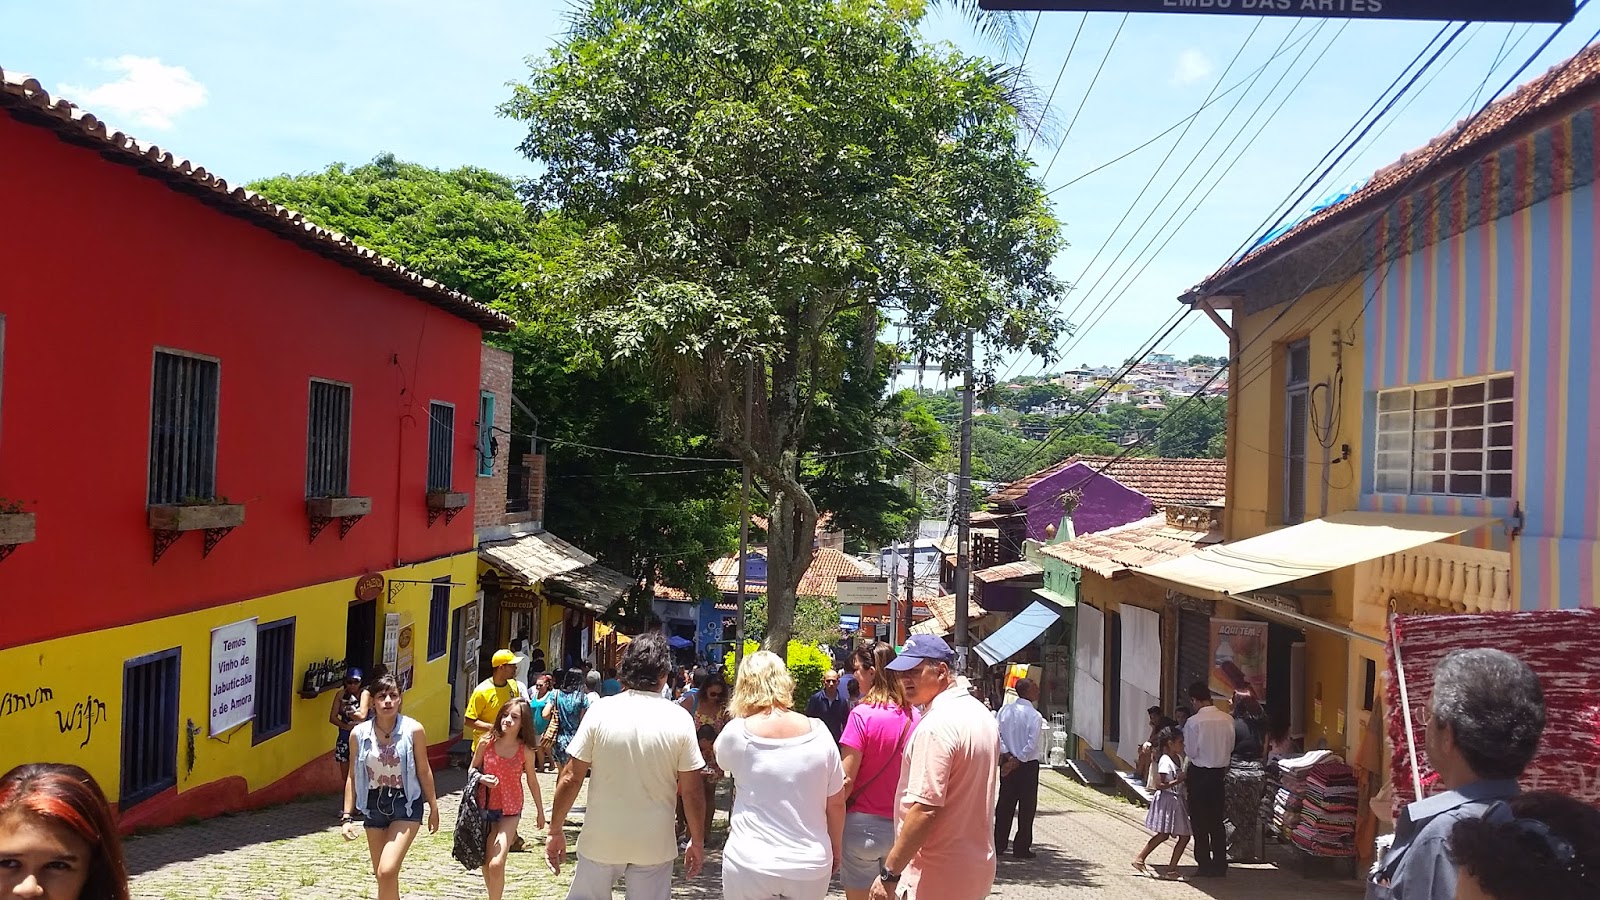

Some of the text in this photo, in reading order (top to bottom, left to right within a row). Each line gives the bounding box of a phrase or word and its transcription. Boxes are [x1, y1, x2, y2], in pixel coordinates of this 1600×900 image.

[1242, 0, 1291, 10] DAS
[1300, 0, 1382, 12] ARTES
[1219, 625, 1239, 635] AQUI
[223, 637, 246, 652] Temos
[218, 655, 250, 674] Vinho de
[213, 674, 253, 697] Jabuticaba
[212, 694, 252, 718] e de Amora
